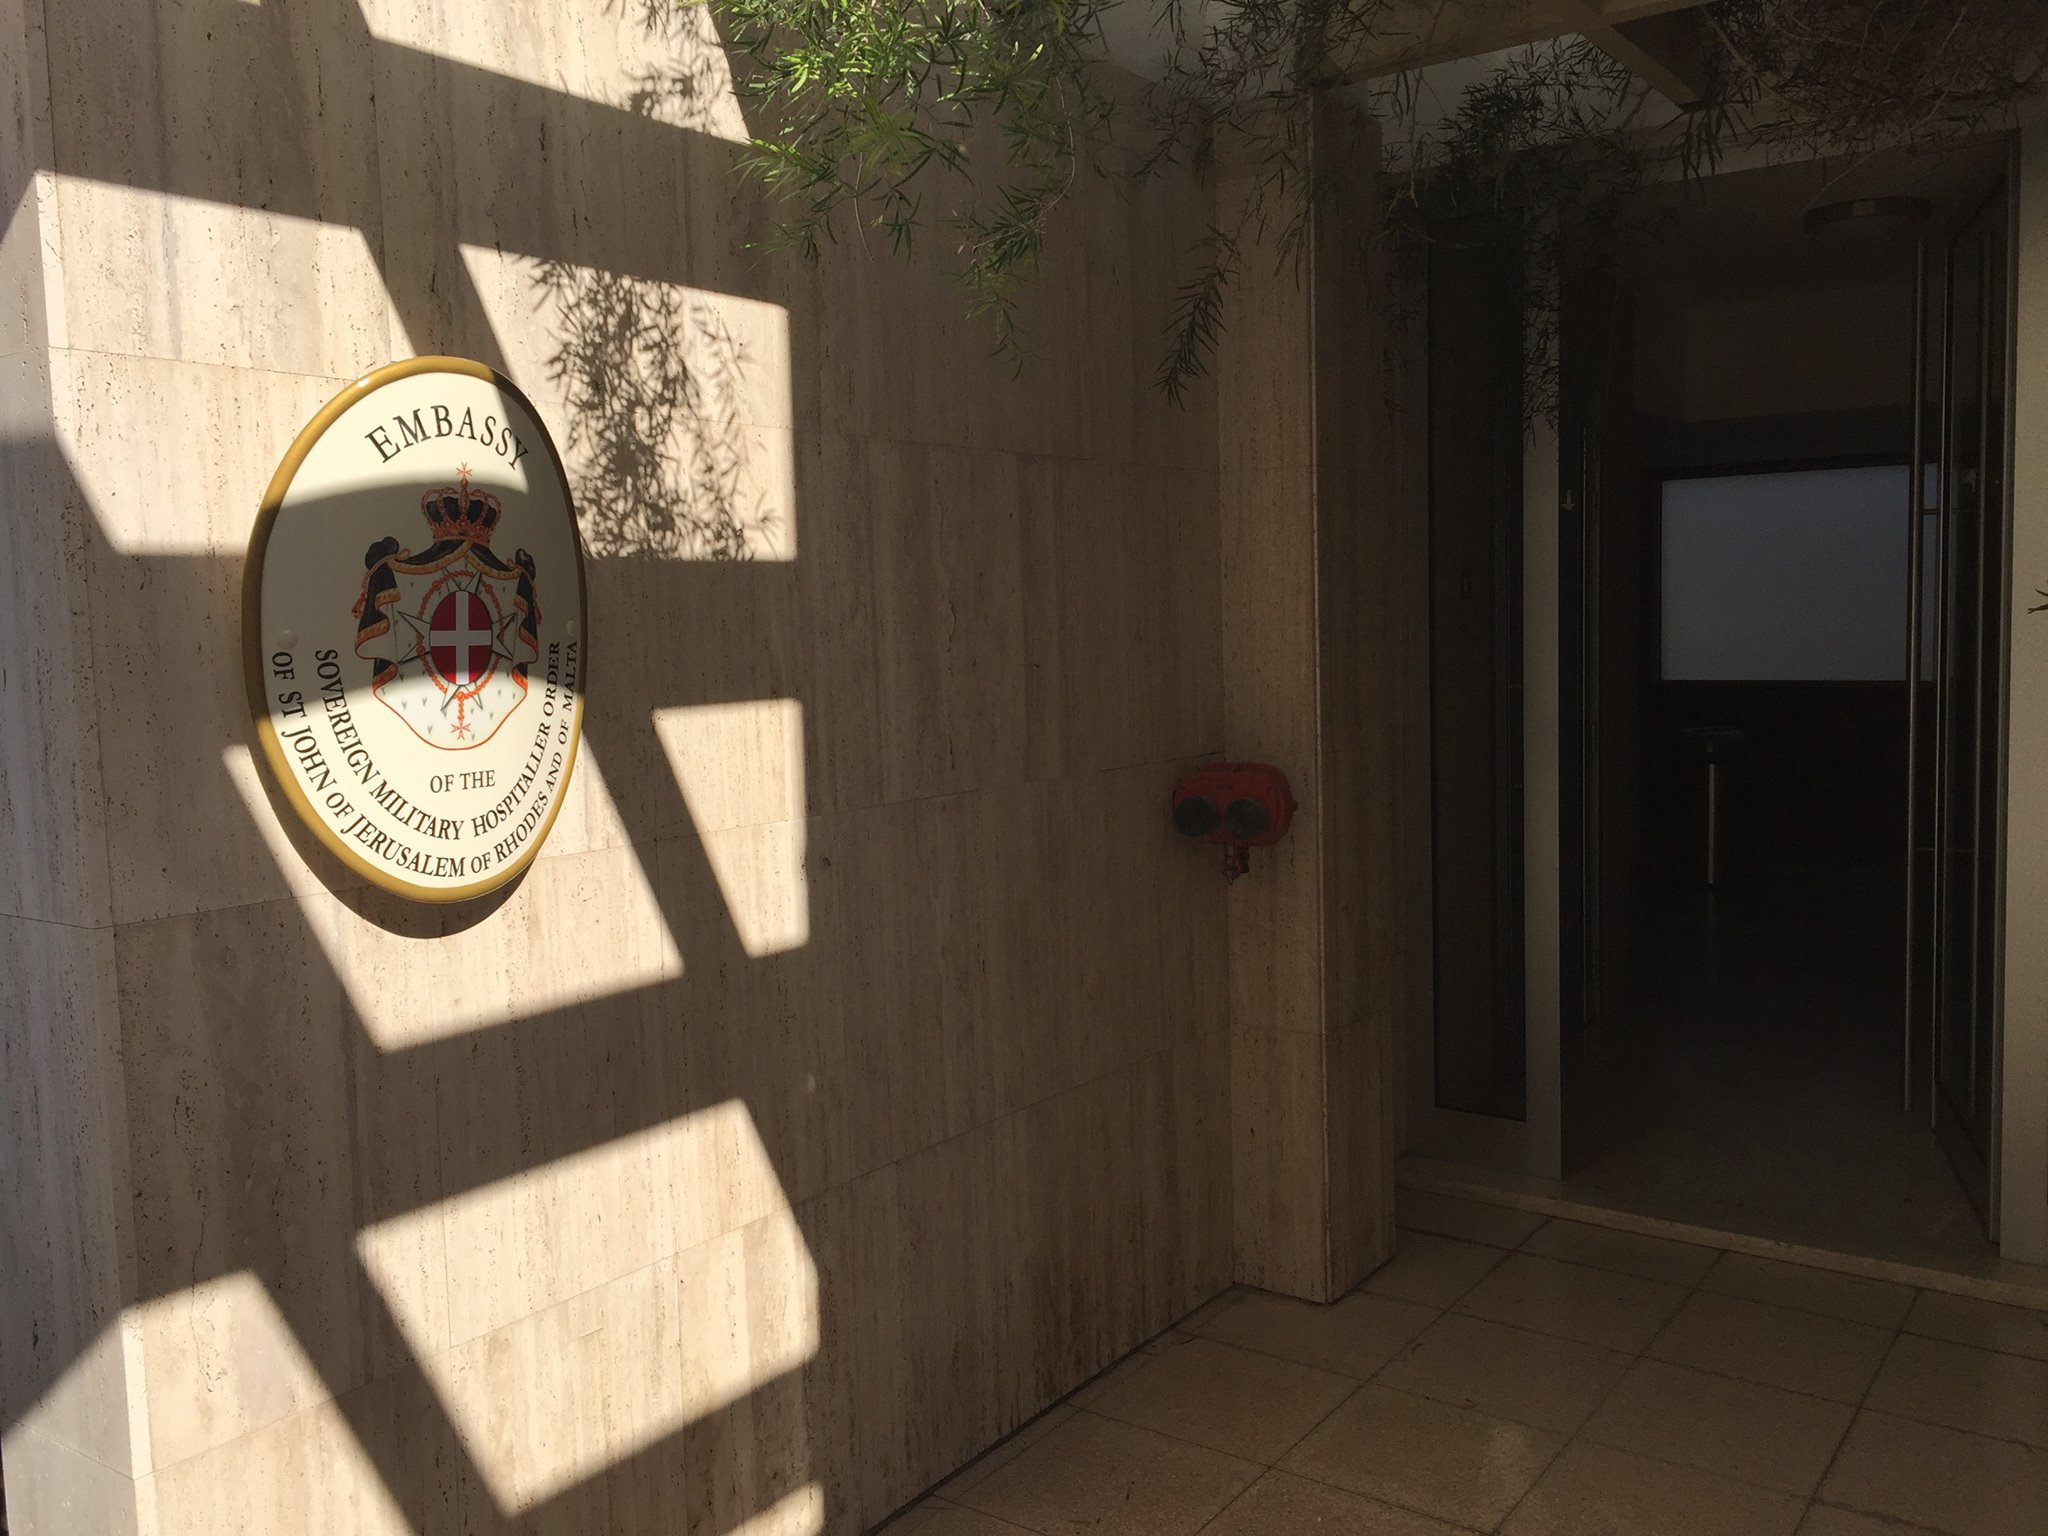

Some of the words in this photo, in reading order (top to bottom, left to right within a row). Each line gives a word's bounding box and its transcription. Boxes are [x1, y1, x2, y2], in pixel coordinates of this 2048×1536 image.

[365, 404, 529, 471] EMBASSY
[272, 651, 294, 679] OF
[562, 640, 578, 712] MALTA
[278, 691, 306, 719] ST
[315, 649, 380, 785] SOVEREIGN
[370, 778, 464, 840] MILITARY
[471, 721, 551, 837] HOSPITALLER
[543, 641, 560, 716] ORDER
[558, 719, 570, 745] OF
[281, 726, 337, 793] JOHN
[546, 752, 563, 793] AND
[430, 775, 454, 793] OF
[459, 771, 496, 790] THE
[326, 792, 354, 819] OF
[341, 813, 466, 878] JERUSALEM
[495, 795, 549, 863] RHODES
[471, 852, 493, 874] OF
